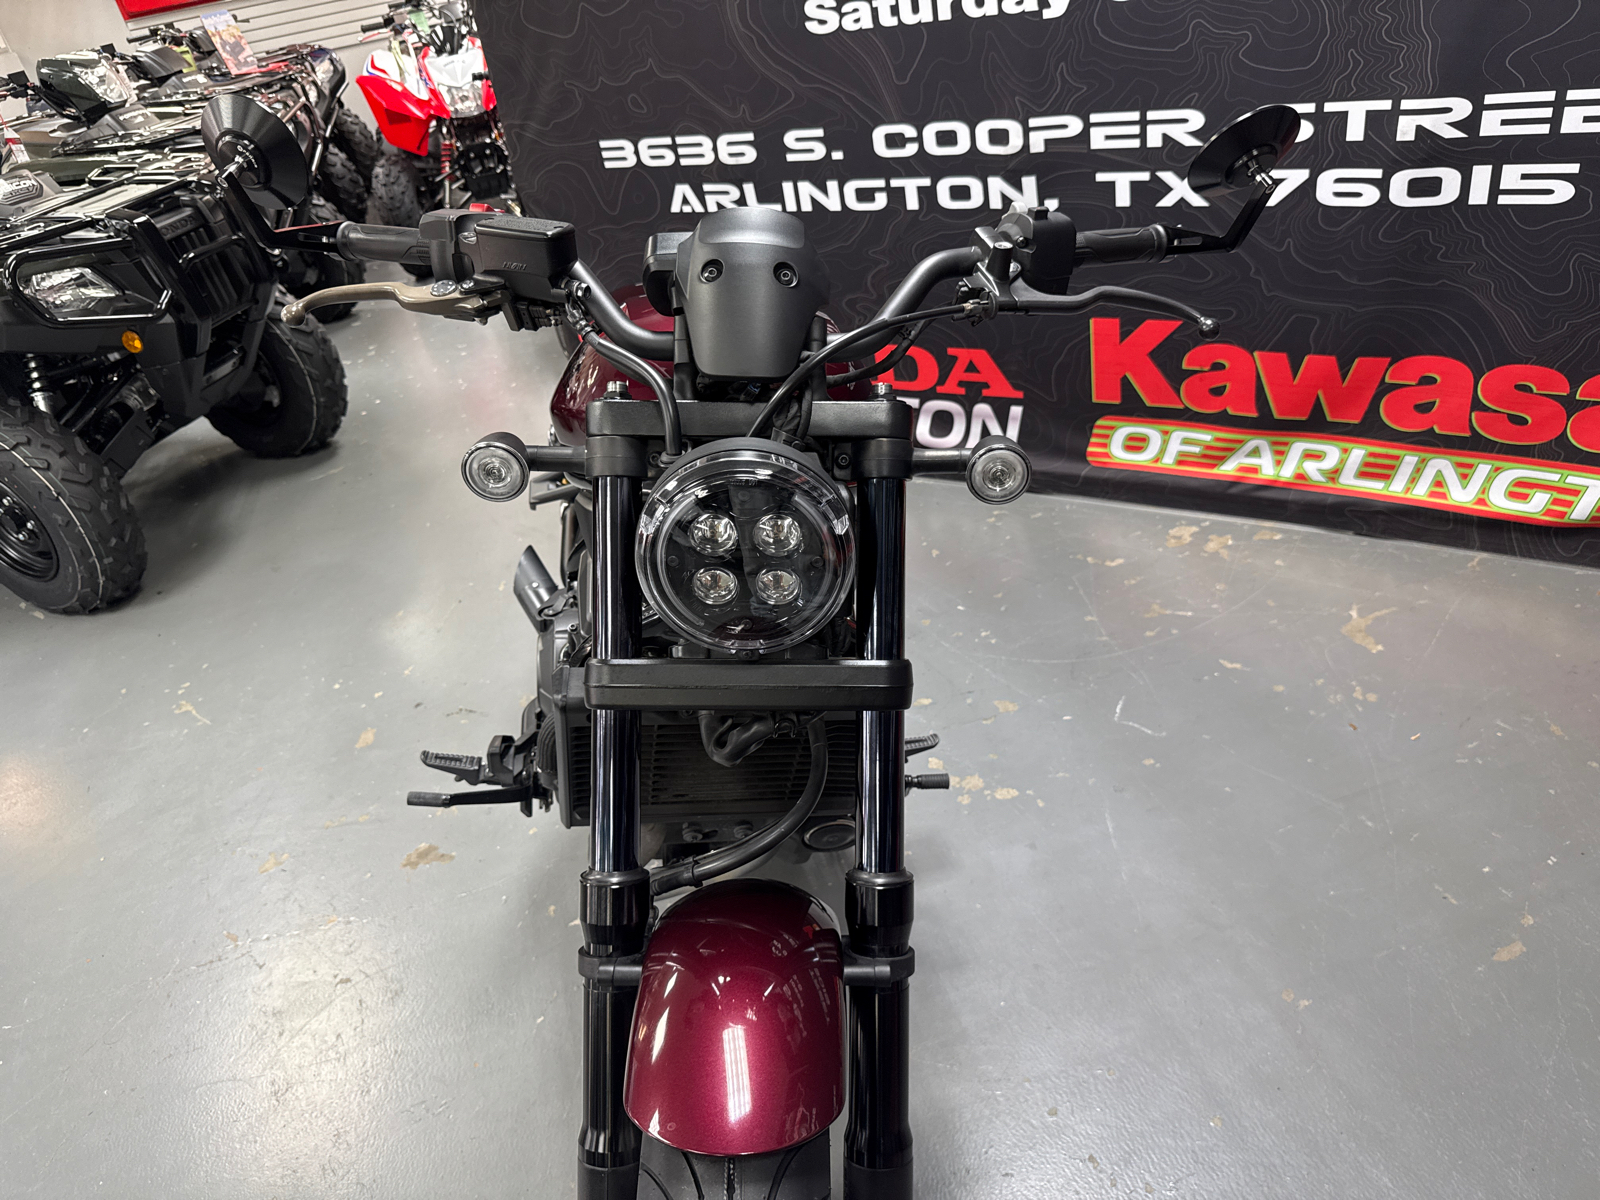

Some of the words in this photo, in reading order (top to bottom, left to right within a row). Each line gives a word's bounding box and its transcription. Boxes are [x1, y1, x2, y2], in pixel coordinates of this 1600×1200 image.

[803, 0, 1071, 35] Saturday
[598, 132, 758, 169] 3636
[783, 128, 845, 162] S.
[871, 108, 1205, 158] COOPER
[670, 174, 1060, 213] ARLINGTON,
[1096, 171, 1211, 208] TX
[1267, 162, 1581, 208] 76015
[1109, 425, 1214, 465] OF
[1218, 437, 1600, 521] ARLINGT
